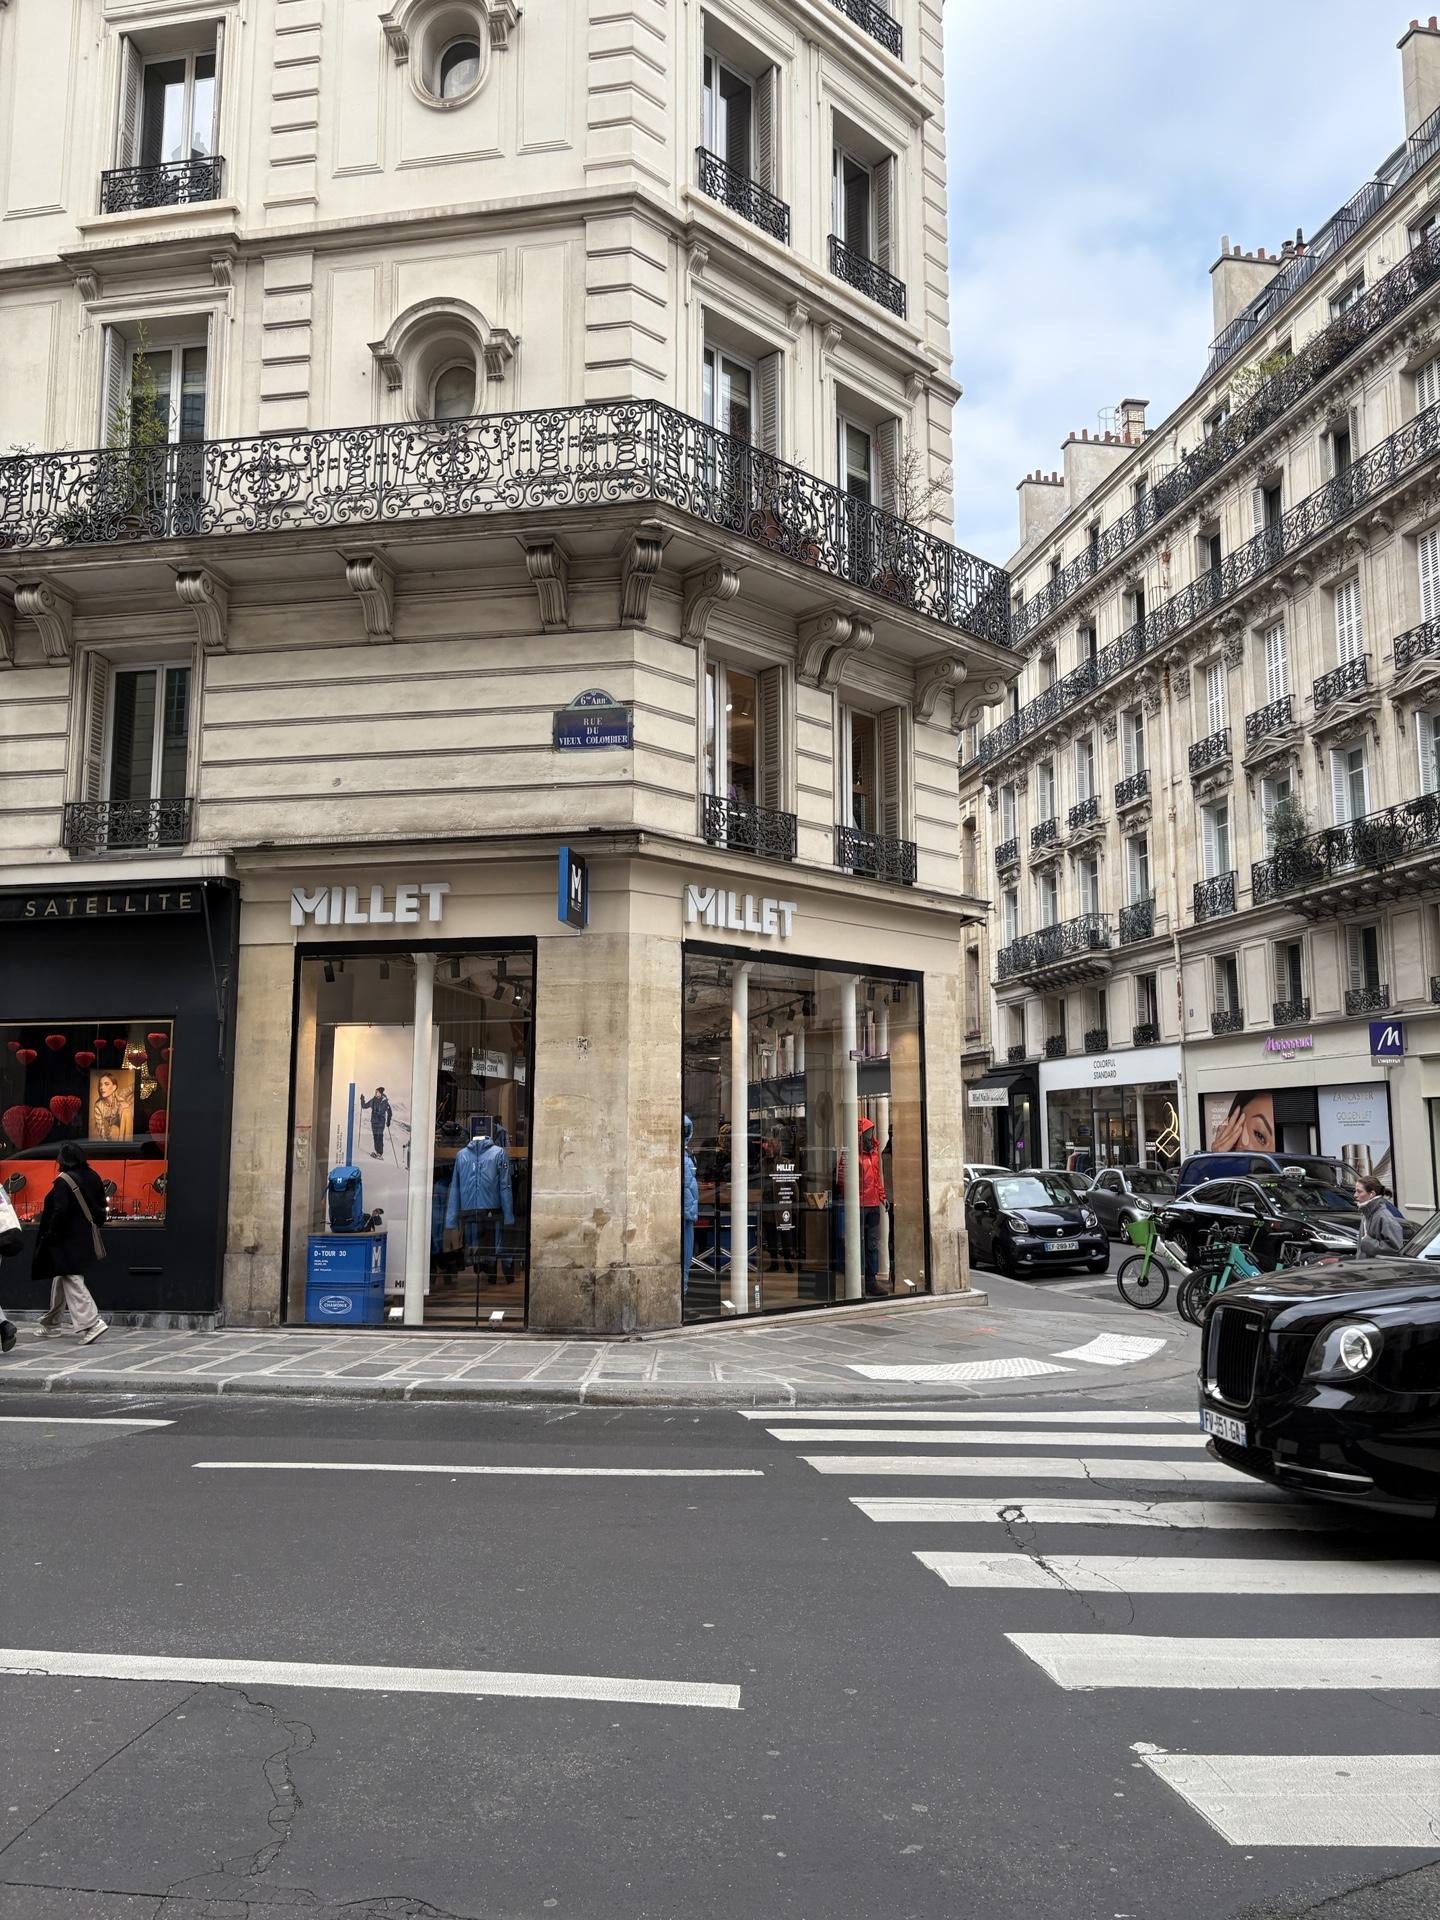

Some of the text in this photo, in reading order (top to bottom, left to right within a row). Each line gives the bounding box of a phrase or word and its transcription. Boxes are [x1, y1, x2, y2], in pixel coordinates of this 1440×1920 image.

[583, 717, 602, 726] RUE
[586, 727, 599, 735] DU
[559, 735, 628, 746] VIEUX COLOMBIER
[24, 892, 192, 917] SATELLITE
[290, 883, 450, 926] MILLET
[685, 884, 797, 937] MILLET
[1093, 1059, 1116, 1068] COLORFUL
[1093, 1070, 1117, 1080] STANDARD
[776, 1163, 795, 1172] MILLET
